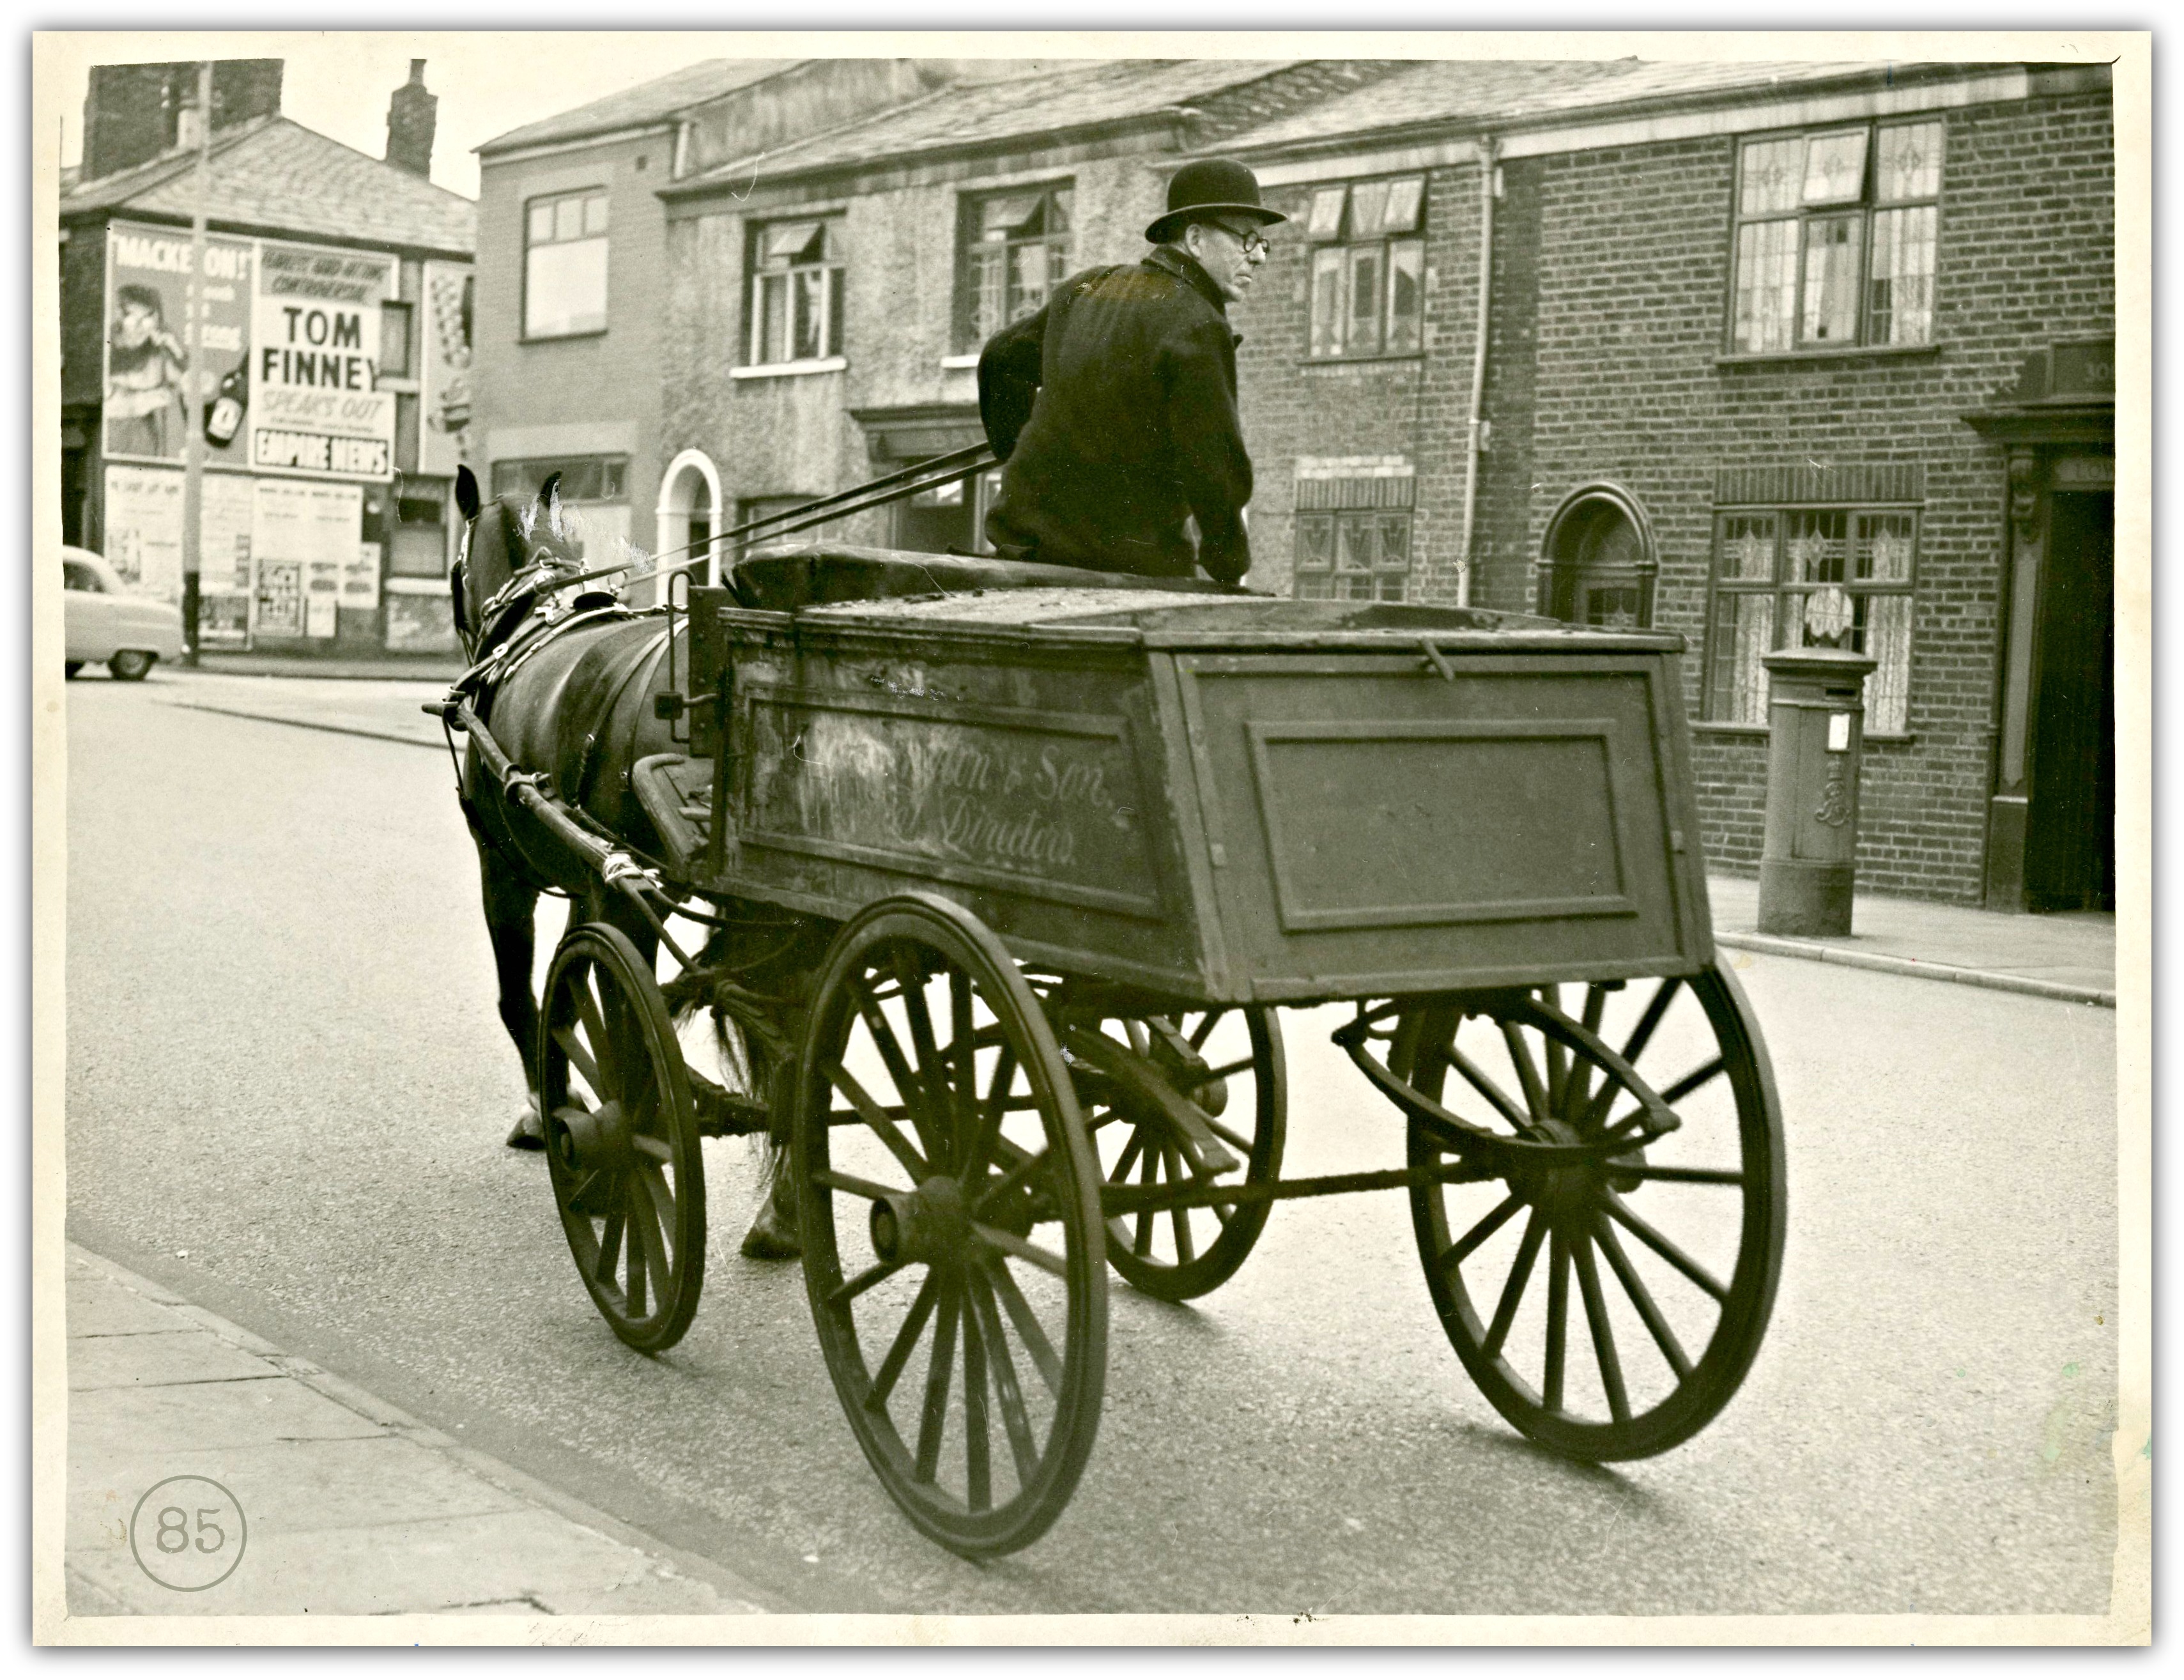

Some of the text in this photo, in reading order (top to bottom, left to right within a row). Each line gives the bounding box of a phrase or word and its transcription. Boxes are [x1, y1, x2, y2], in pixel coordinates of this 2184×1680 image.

[117, 235, 247, 280] MACKEON!
[283, 307, 360, 349] TOM
[263, 347, 381, 392] FINNEY
[263, 390, 384, 420] SPEAKS OUT
[257, 430, 387, 475] EMPIRE NEWS
